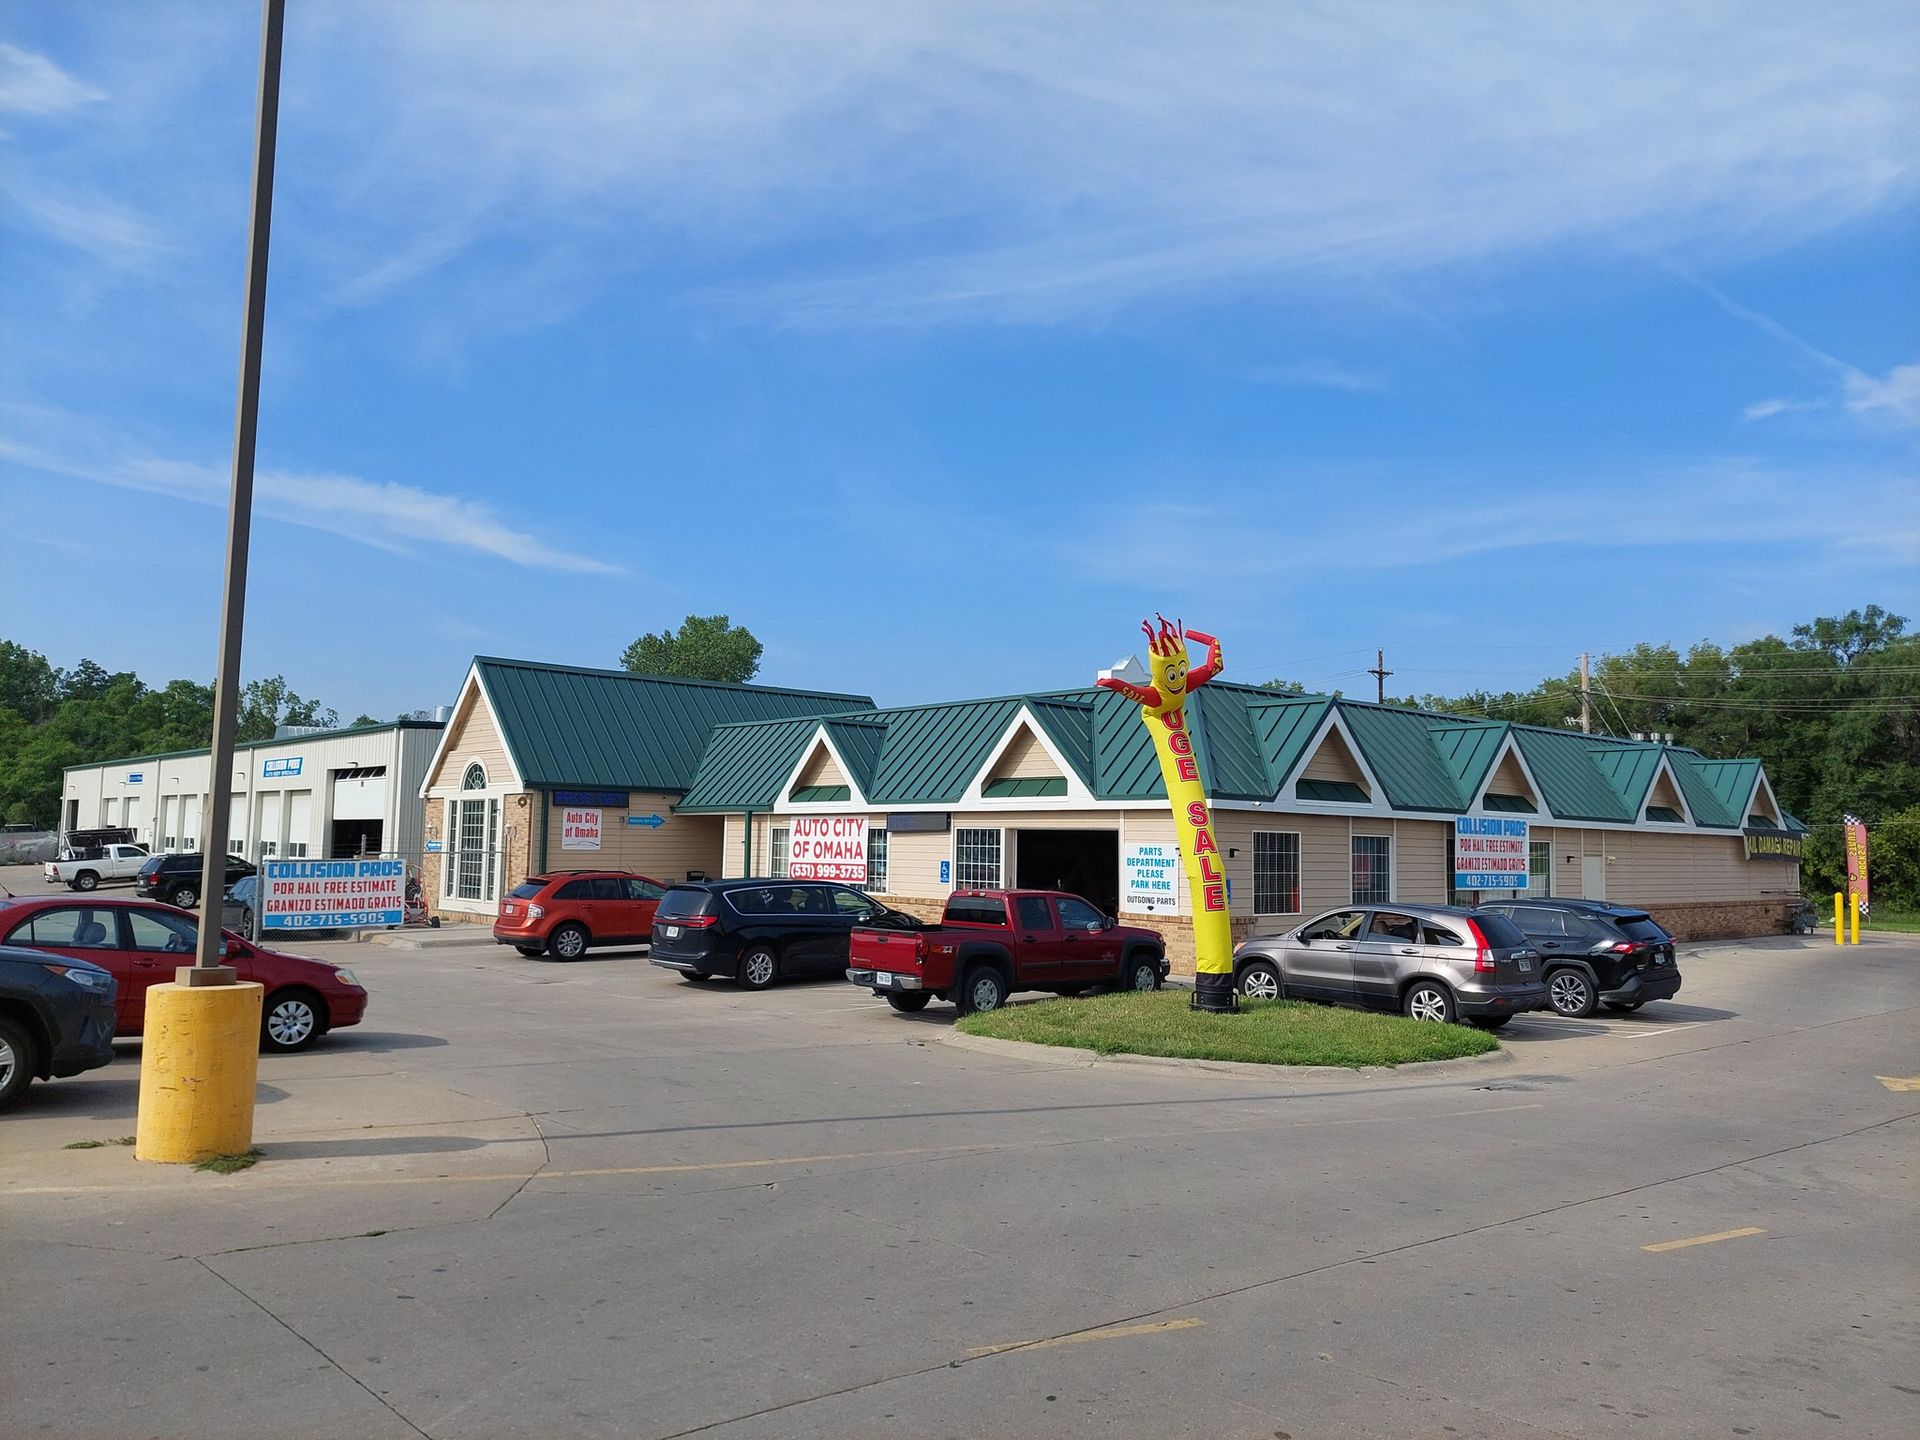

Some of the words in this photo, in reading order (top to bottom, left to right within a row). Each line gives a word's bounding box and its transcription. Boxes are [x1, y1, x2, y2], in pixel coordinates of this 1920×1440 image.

[1161, 708, 1199, 782] UGE
[1187, 800, 1225, 912] SALE
[566, 811, 583, 823] Auto
[584, 812, 599, 825] City
[565, 827, 573, 838] of
[575, 827, 599, 838] Omaha
[794, 818, 830, 837] AUTO
[833, 818, 864, 837] CITY
[1456, 817, 1503, 835] COLLISION
[1503, 820, 1527, 837] PROS
[793, 841, 809, 859] OF
[813, 841, 864, 860] OMAHA
[1138, 847, 1163, 856] PARTS
[1472, 838, 1485, 852] HAIL
[1486, 839, 1499, 853] FREE
[1499, 840, 1524, 854] ESTIMATE
[267, 862, 355, 879] COLLISION
[359, 861, 403, 877] PROS
[1126, 857, 1176, 868] DEPARTMENT
[1456, 856, 1481, 871] GRANIZO
[1481, 857, 1507, 871] ESTIMADO
[790, 864, 816, 879] (531)
[816, 865, 865, 879] 999-3735
[1137, 869, 1165, 879] PLEASE
[298, 882, 320, 895] HAIL
[323, 881, 347, 894] FREE
[351, 880, 397, 893] ESTIMATE
[1130, 880, 1150, 889] PARK
[1151, 880, 1171, 890] HERE
[1466, 874, 1519, 887] 402-715-5905
[267, 899, 311, 912] GRANIZO
[315, 897, 364, 911] ESTIMADO
[368, 896, 402, 909] GRATIS
[1126, 895, 1155, 905] OUTGOING
[1156, 897, 1176, 906] PARTS
[283, 913, 385, 927] 402-715-5905
